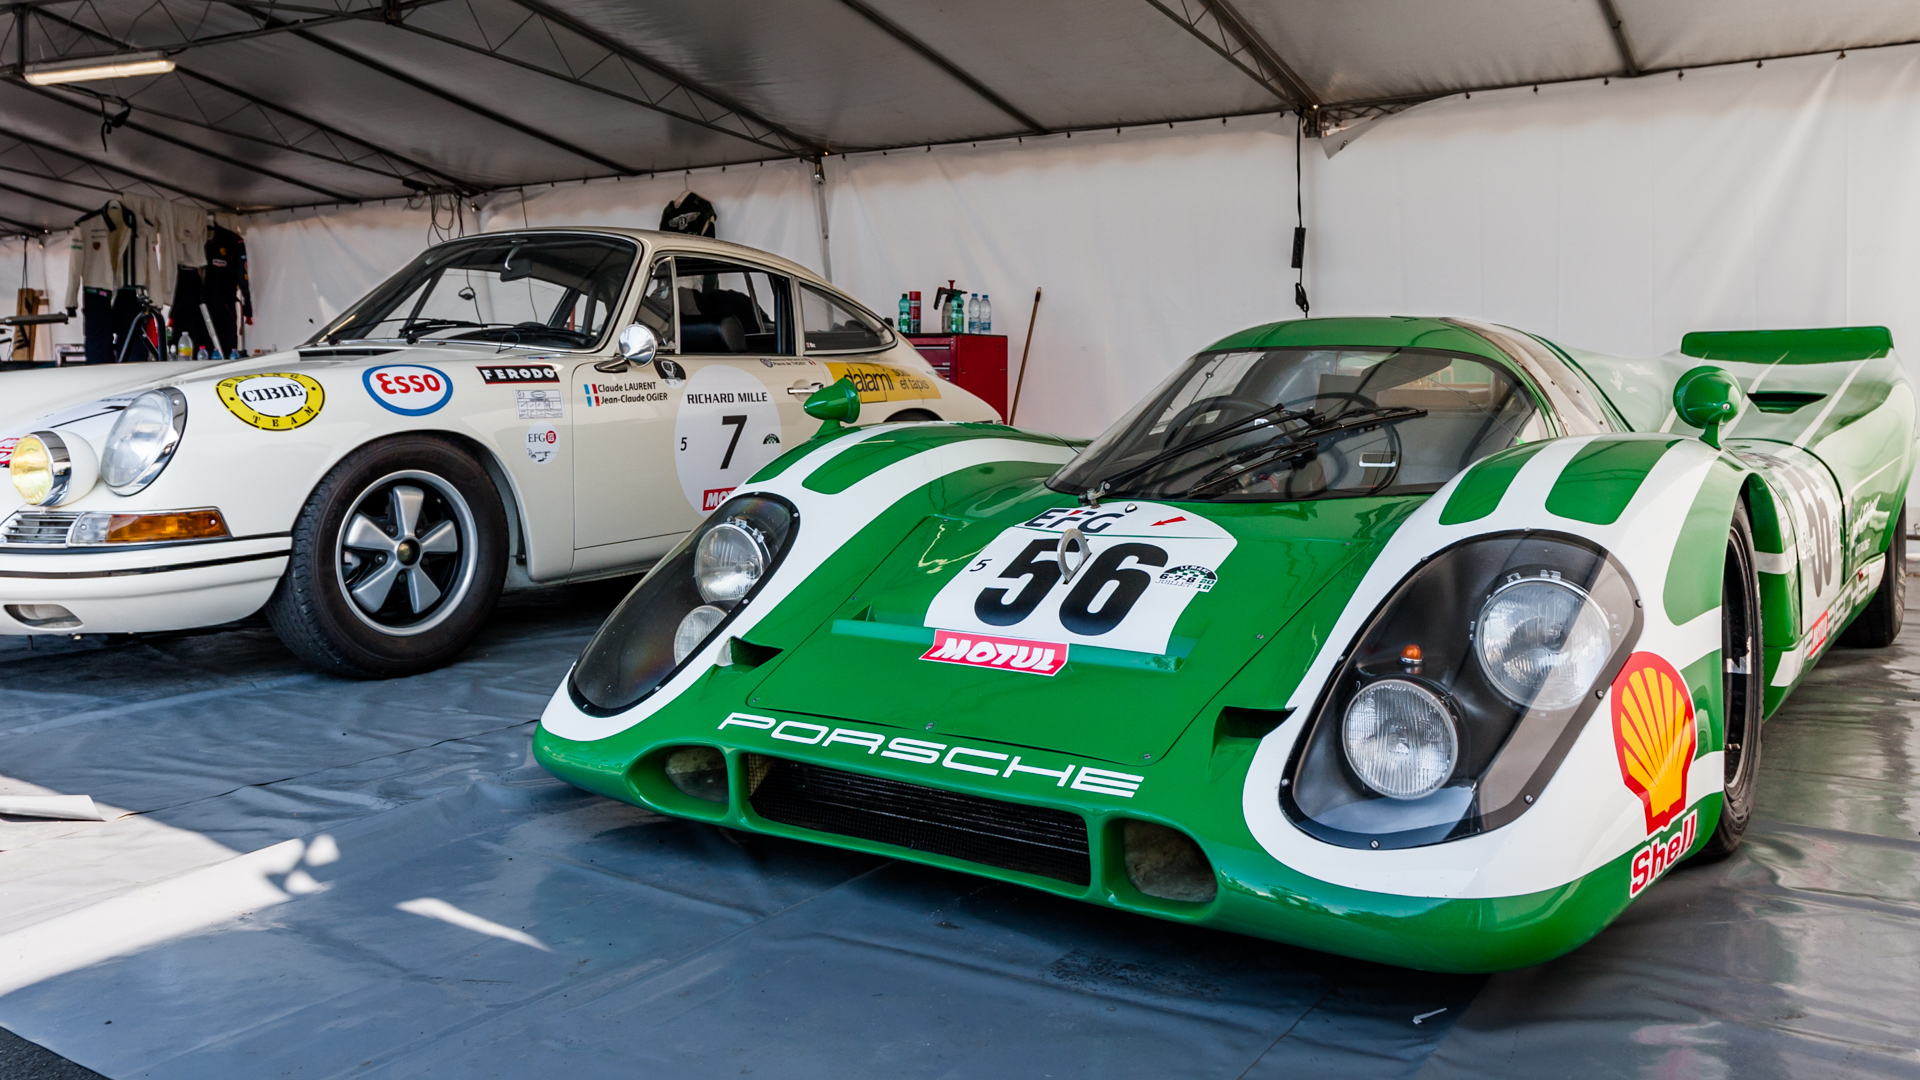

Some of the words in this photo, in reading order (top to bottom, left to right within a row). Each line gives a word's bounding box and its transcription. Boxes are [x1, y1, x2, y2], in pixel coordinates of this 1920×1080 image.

[222, 372, 299, 388] RACING
[481, 367, 555, 380] FERODO
[597, 383, 624, 393] Claude
[624, 381, 656, 391] LAURENT
[899, 378, 909, 390] et
[909, 378, 930, 392] tapis
[600, 394, 646, 405] Jean-Claude
[646, 392, 668, 402] OGIER
[686, 392, 735, 405] RICHARD
[737, 391, 768, 403] MILLE
[253, 406, 315, 428] TEAM
[527, 432, 546, 443] EFG
[680, 437, 687, 451] 5
[720, 415, 747, 469] 7
[1024, 508, 1126, 534] EFG
[969, 558, 993, 572] 5
[1159, 573, 1197, 583] 6-7-8
[974, 538, 1169, 636] 56
[929, 637, 1055, 671] MOTUL
[717, 712, 1144, 798] PORSCHE
[1630, 809, 1697, 898] Shell
